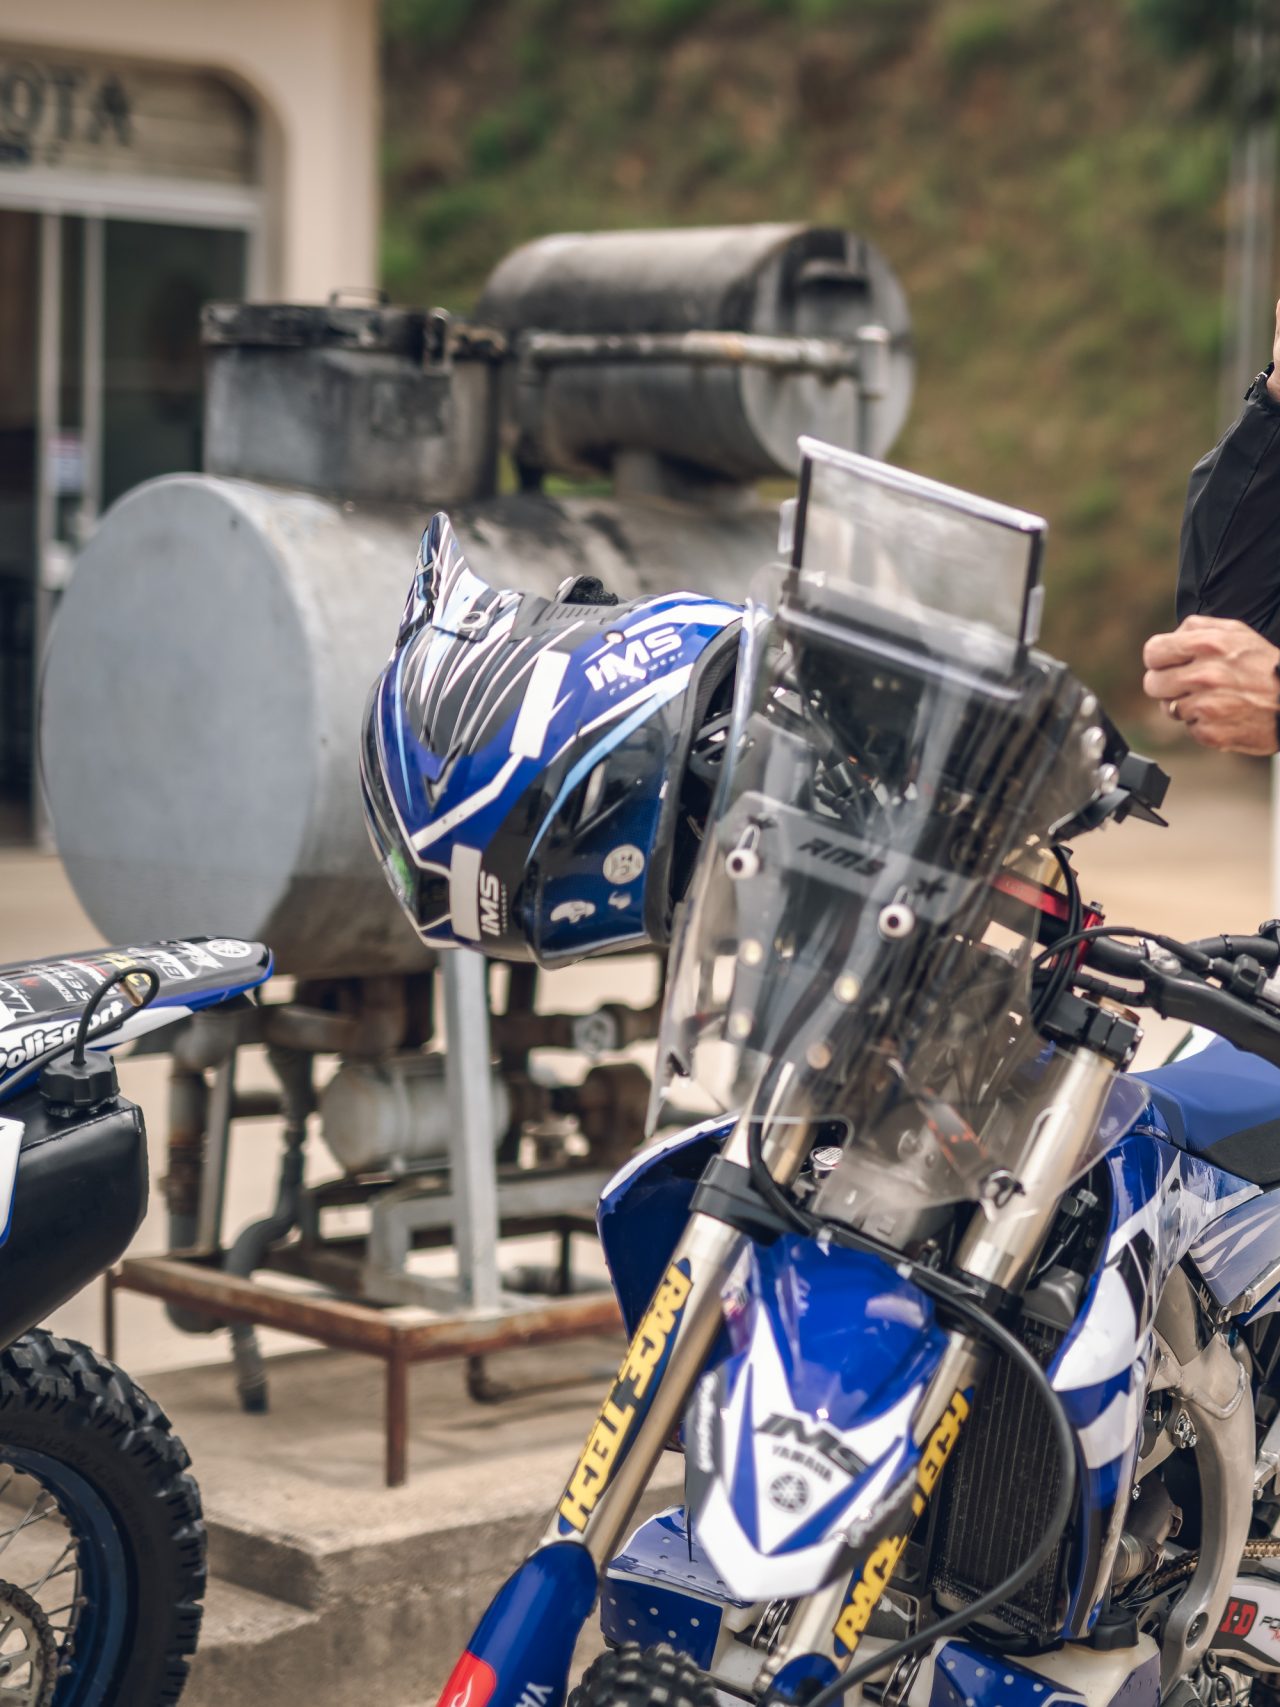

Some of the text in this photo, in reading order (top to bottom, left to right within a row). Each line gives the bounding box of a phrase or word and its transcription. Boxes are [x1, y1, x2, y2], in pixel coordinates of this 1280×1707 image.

[584, 626, 683, 692] IMS
[479, 869, 501, 937] IMS
[0, 1000, 123, 1070] olisport
[558, 1262, 694, 1534] RACE TECH
[772, 1445, 834, 1484] YAMAHA
